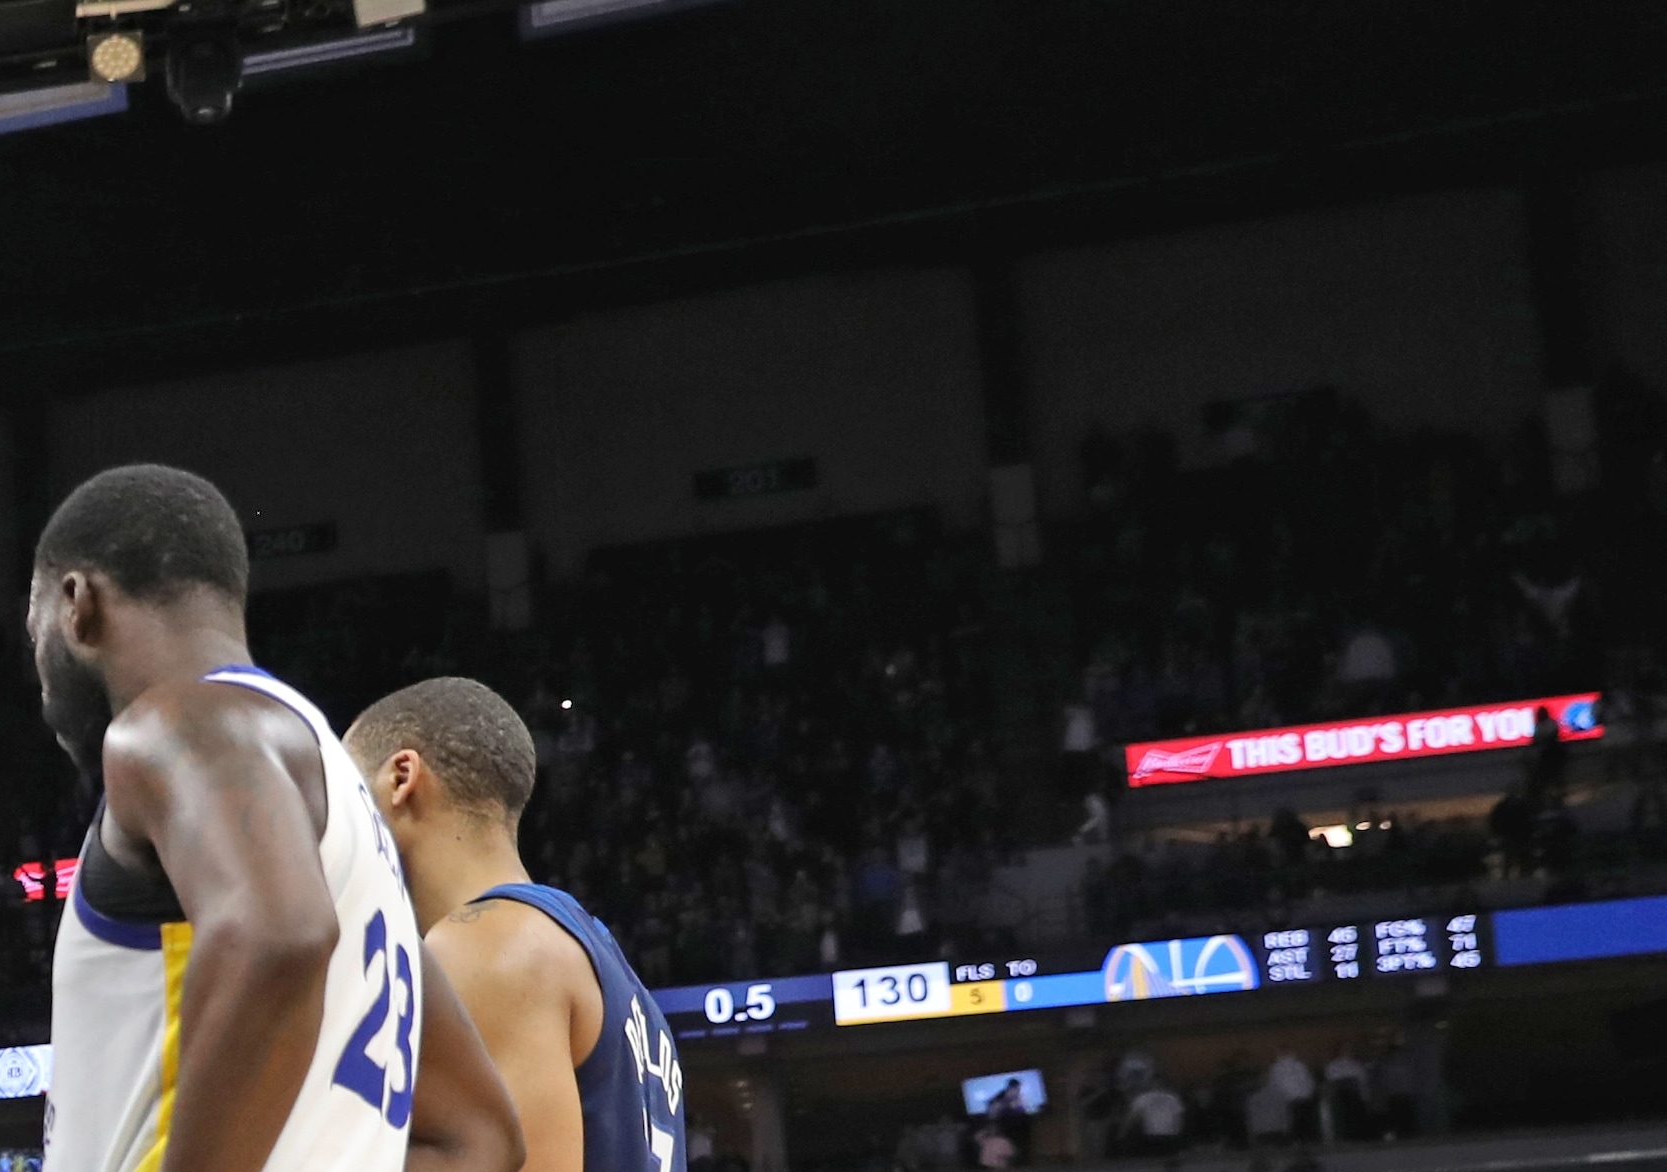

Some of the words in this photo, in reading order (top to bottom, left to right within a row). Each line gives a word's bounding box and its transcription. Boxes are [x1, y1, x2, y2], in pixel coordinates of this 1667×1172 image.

[1225, 733, 1303, 770] THIS
[1305, 718, 1407, 763] BUD'S
[1408, 711, 1474, 752] FOR
[1263, 928, 1310, 949] REB
[1266, 946, 1310, 967] AST
[954, 963, 996, 982] FLS
[1005, 958, 1038, 977] TO
[1267, 962, 1312, 982] STL
[704, 983, 777, 1025] 0.5
[853, 972, 931, 1009] 130
[969, 987, 985, 1006] 5
[331, 908, 414, 1130] 23
